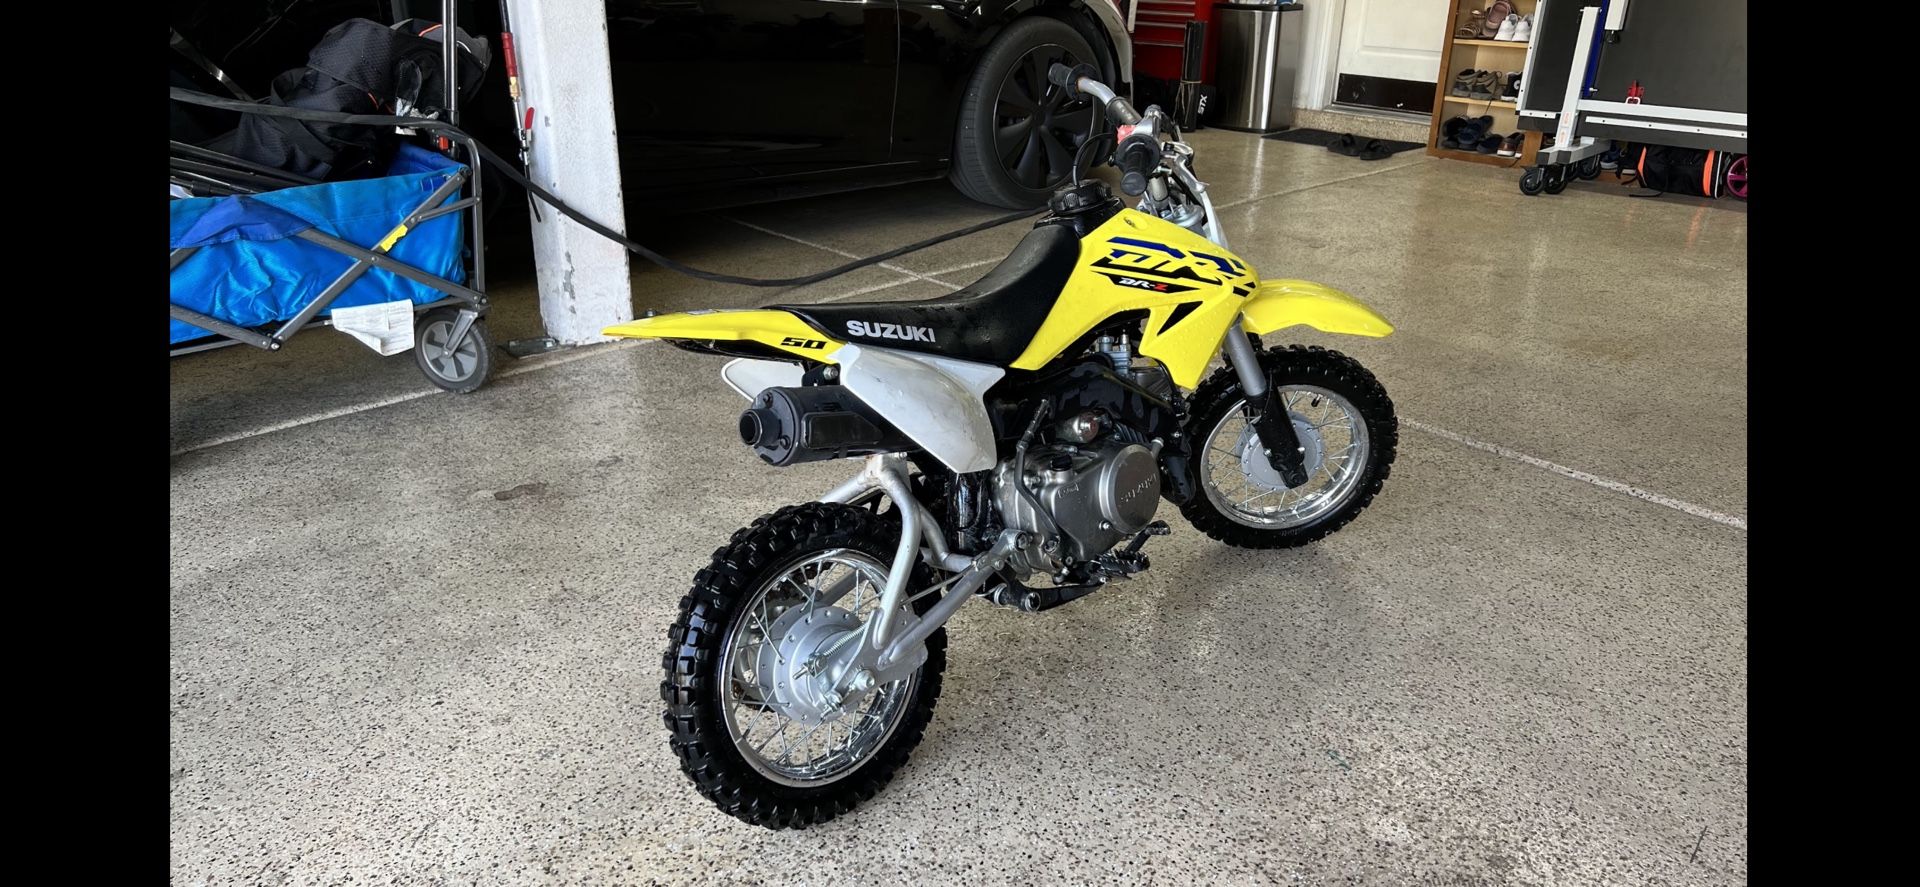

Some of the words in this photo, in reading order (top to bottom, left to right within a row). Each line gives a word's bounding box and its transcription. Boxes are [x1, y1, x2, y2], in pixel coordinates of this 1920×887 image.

[1197, 94, 1208, 115] STX
[1118, 277, 1169, 291] DR-Z
[846, 320, 936, 343] SUZUKI
[781, 337, 827, 350] 50
